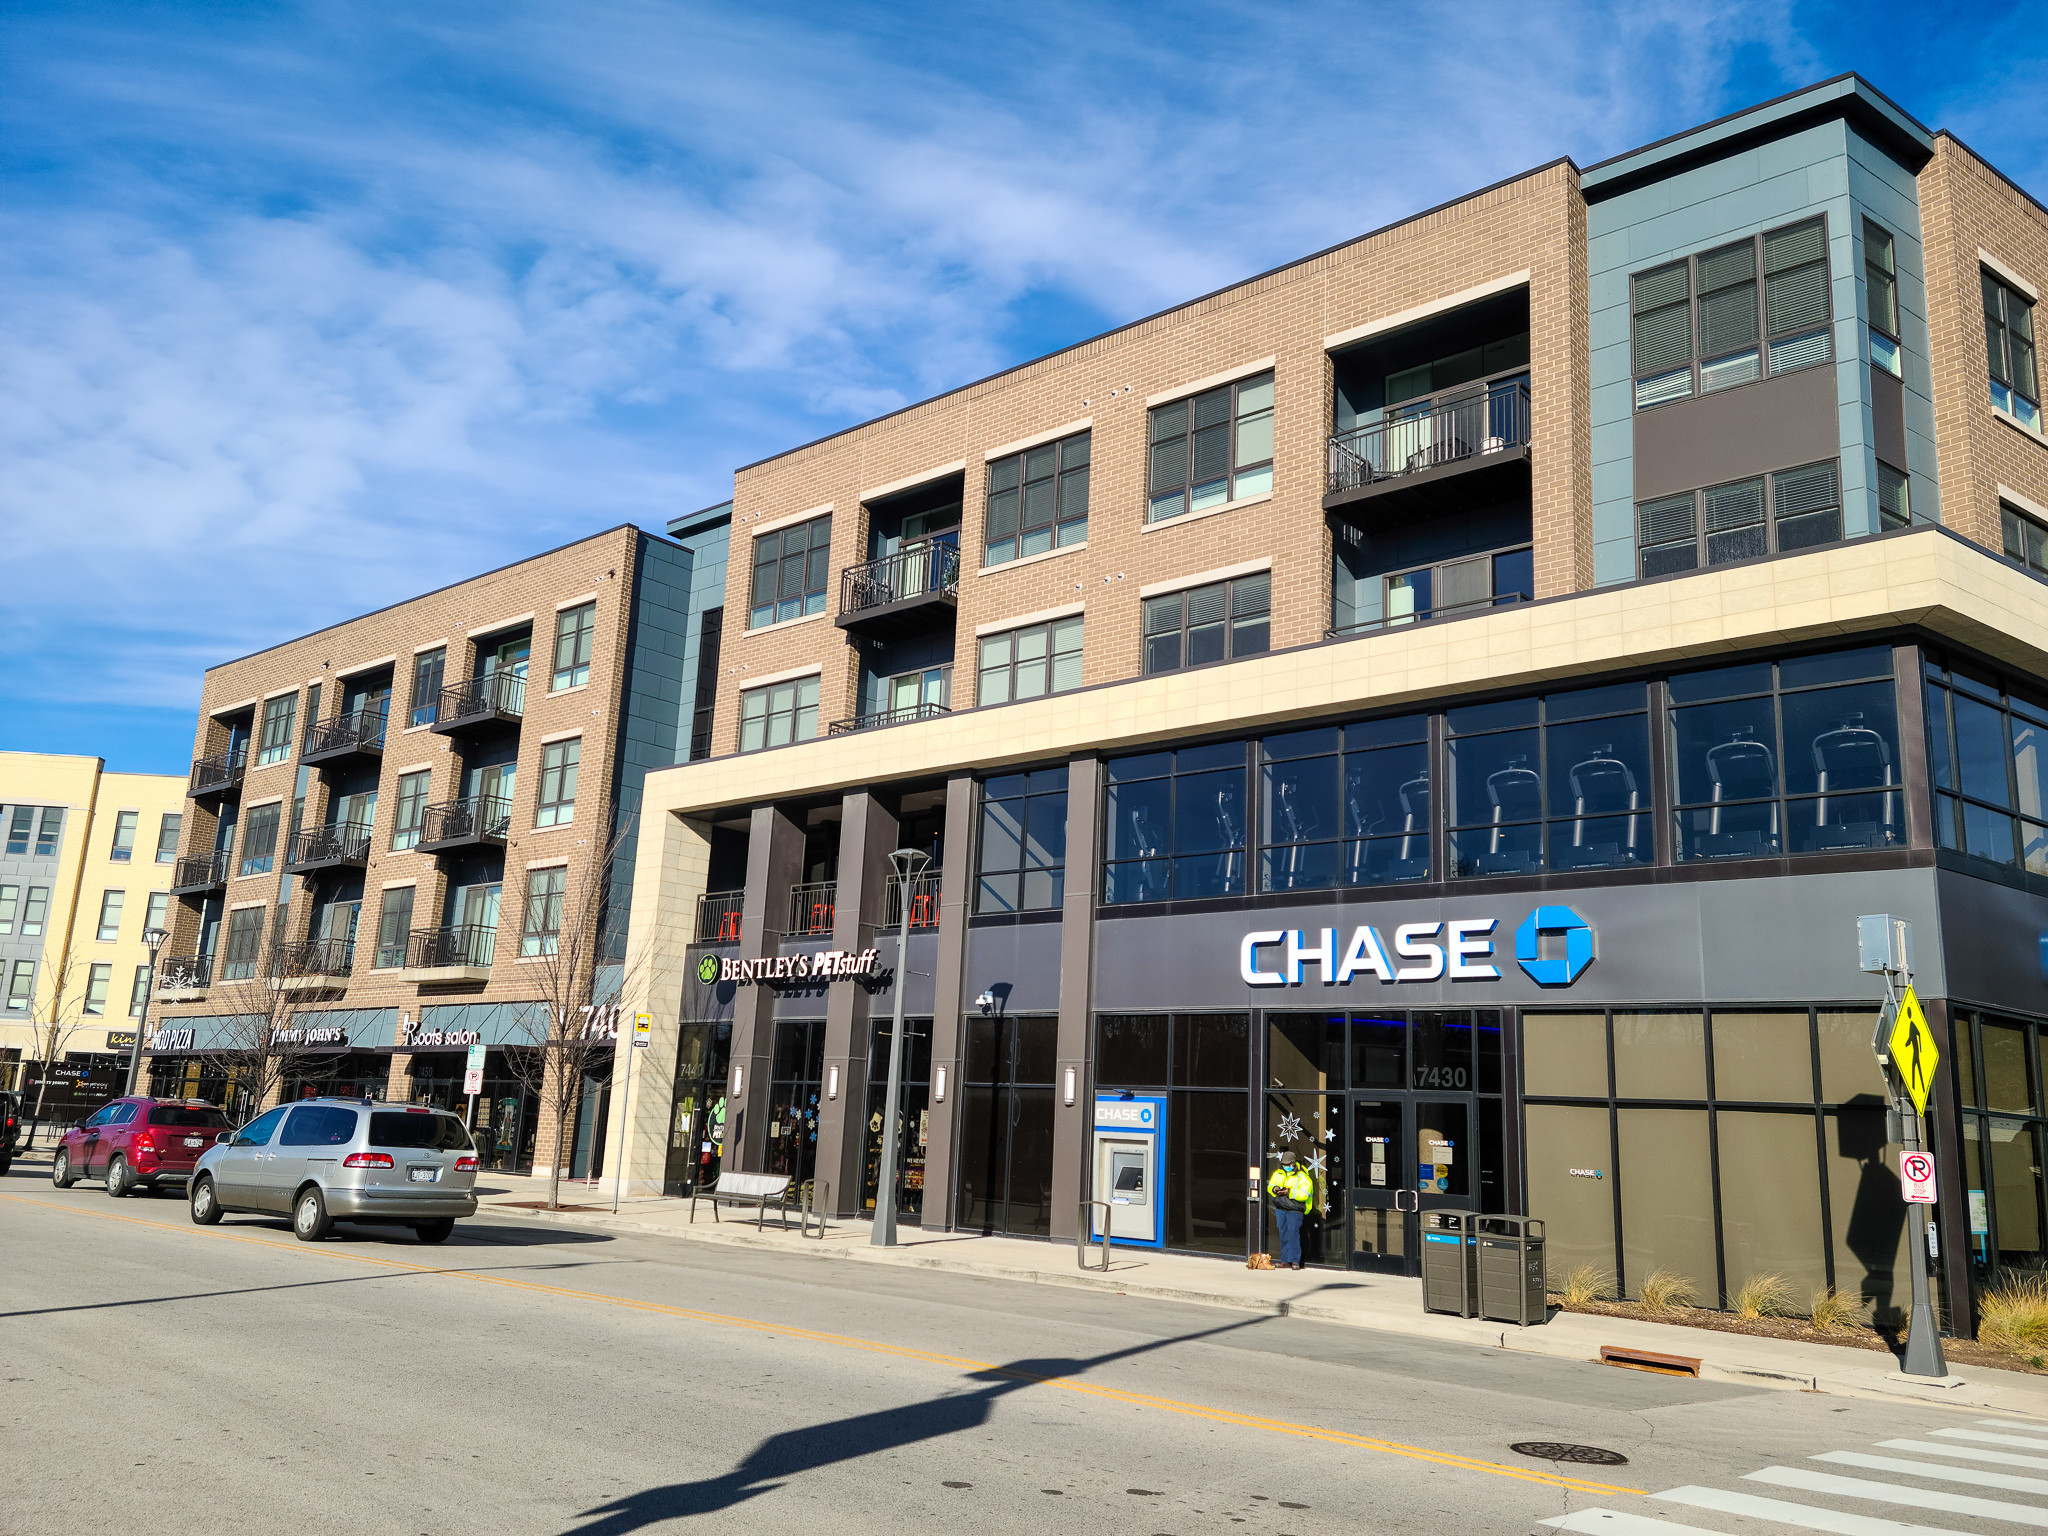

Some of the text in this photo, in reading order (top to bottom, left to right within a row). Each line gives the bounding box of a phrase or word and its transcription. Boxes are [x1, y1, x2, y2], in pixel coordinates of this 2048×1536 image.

[1241, 919, 1500, 986] CHASE
[720, 948, 876, 981] BENTLEY'S PETstuff
[152, 1028, 193, 1050] MOD PIZZA
[304, 1027, 341, 1046] JOHN'S
[404, 1021, 442, 1045] Roots
[55, 1069, 81, 1077] CHASE
[680, 1063, 703, 1078] 7440
[1417, 1067, 1467, 1088] 7430
[1096, 1108, 1138, 1121] CHASE
[1570, 1168, 1595, 1176] CHASE
